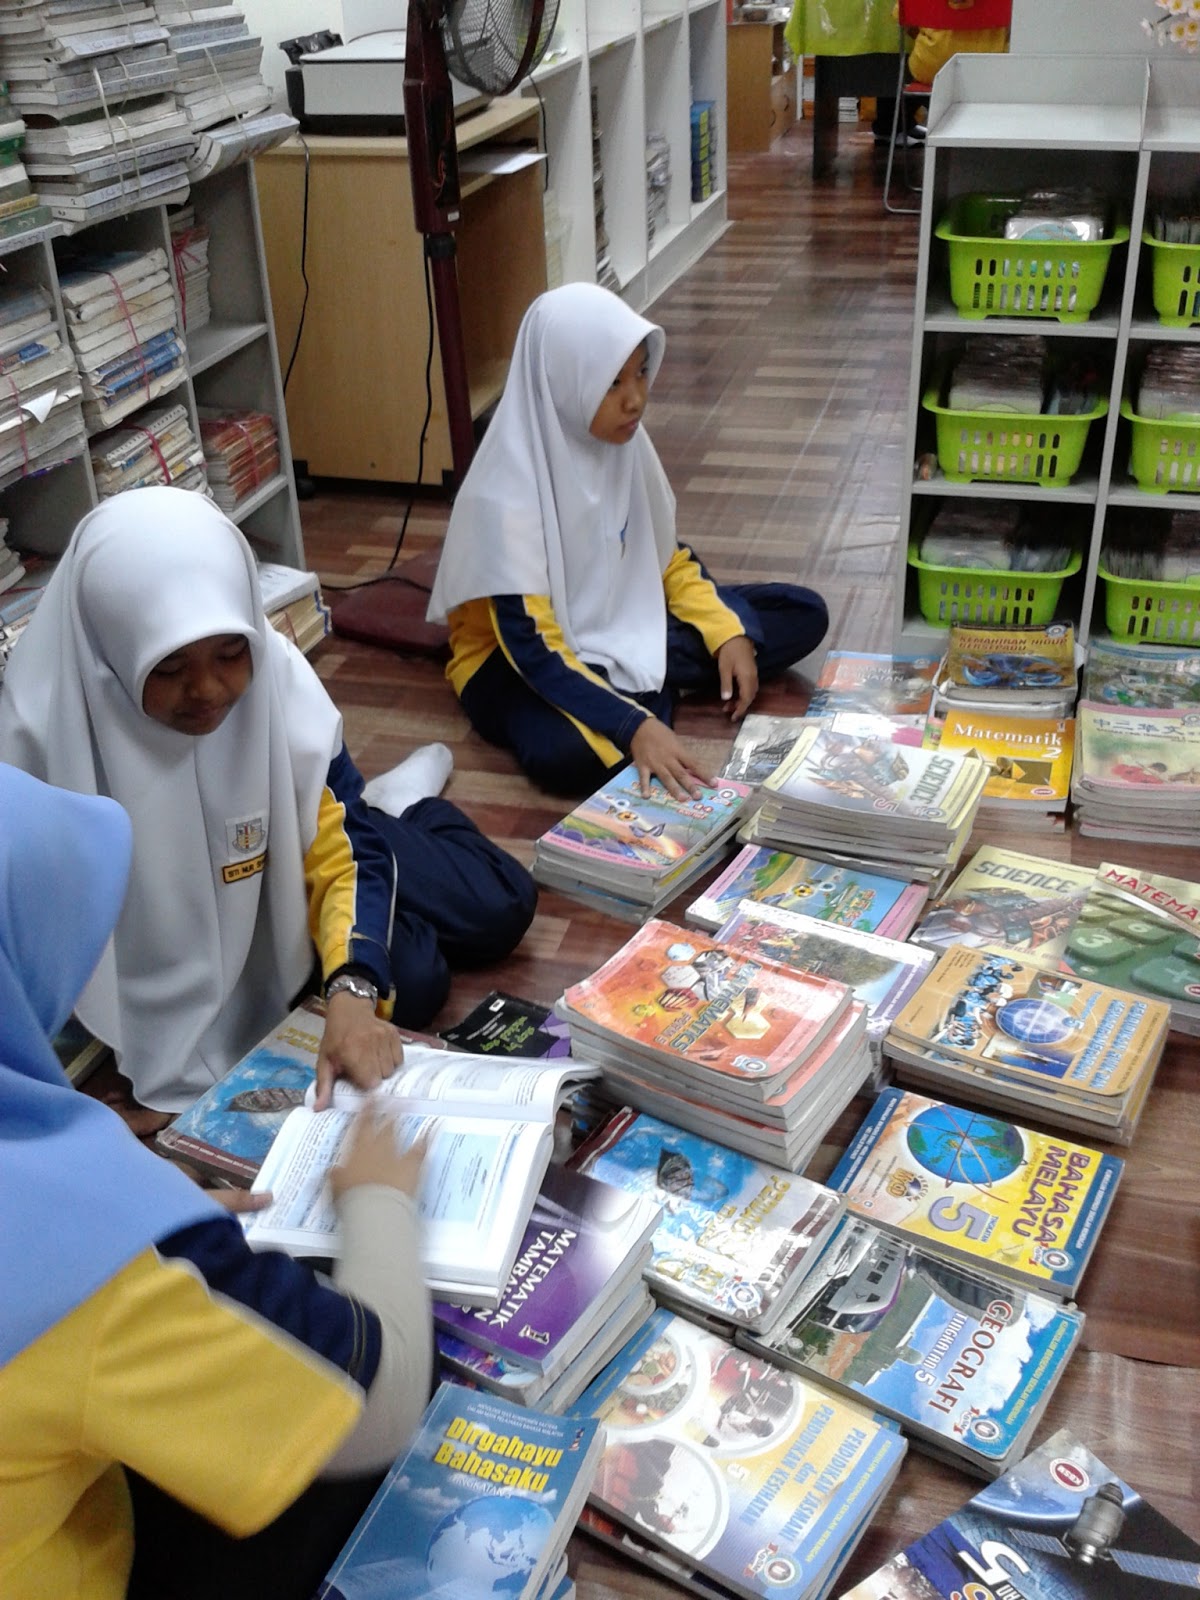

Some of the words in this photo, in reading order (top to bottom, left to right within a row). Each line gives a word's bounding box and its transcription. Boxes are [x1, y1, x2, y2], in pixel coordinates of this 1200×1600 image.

[952, 723, 1063, 746] Matematik
[1041, 746, 1063, 759] 2
[909, 755, 954, 805] SCIENCE
[973, 860, 1079, 894] SCIENCE
[1104, 869, 1200, 921] MATEMA
[670, 960, 762, 1055] MATHEMATICS
[1012, 1145, 1066, 1238] MELAYU
[1034, 1151, 1091, 1243] BAHASA
[929, 1196, 992, 1240] 5
[474, 1230, 557, 1323] TAMBAN
[488, 1228, 577, 1329] MATEMATIK
[927, 1312, 968, 1371] TINGKATAN
[928, 1299, 1013, 1415] GEOGRAFI
[914, 1369, 936, 1386] 5
[446, 1416, 564, 1468] Dirgahayu
[785, 1404, 834, 1470] PENDIDIKAN
[813, 1427, 867, 1496] PENDIDIKAN
[433, 1442, 550, 1493] Bahasaku
[794, 1462, 818, 1485] dan
[738, 1464, 790, 1527] KESIHATAN
[779, 1490, 822, 1541] JASMANI
[957, 1540, 1031, 1586] 5
